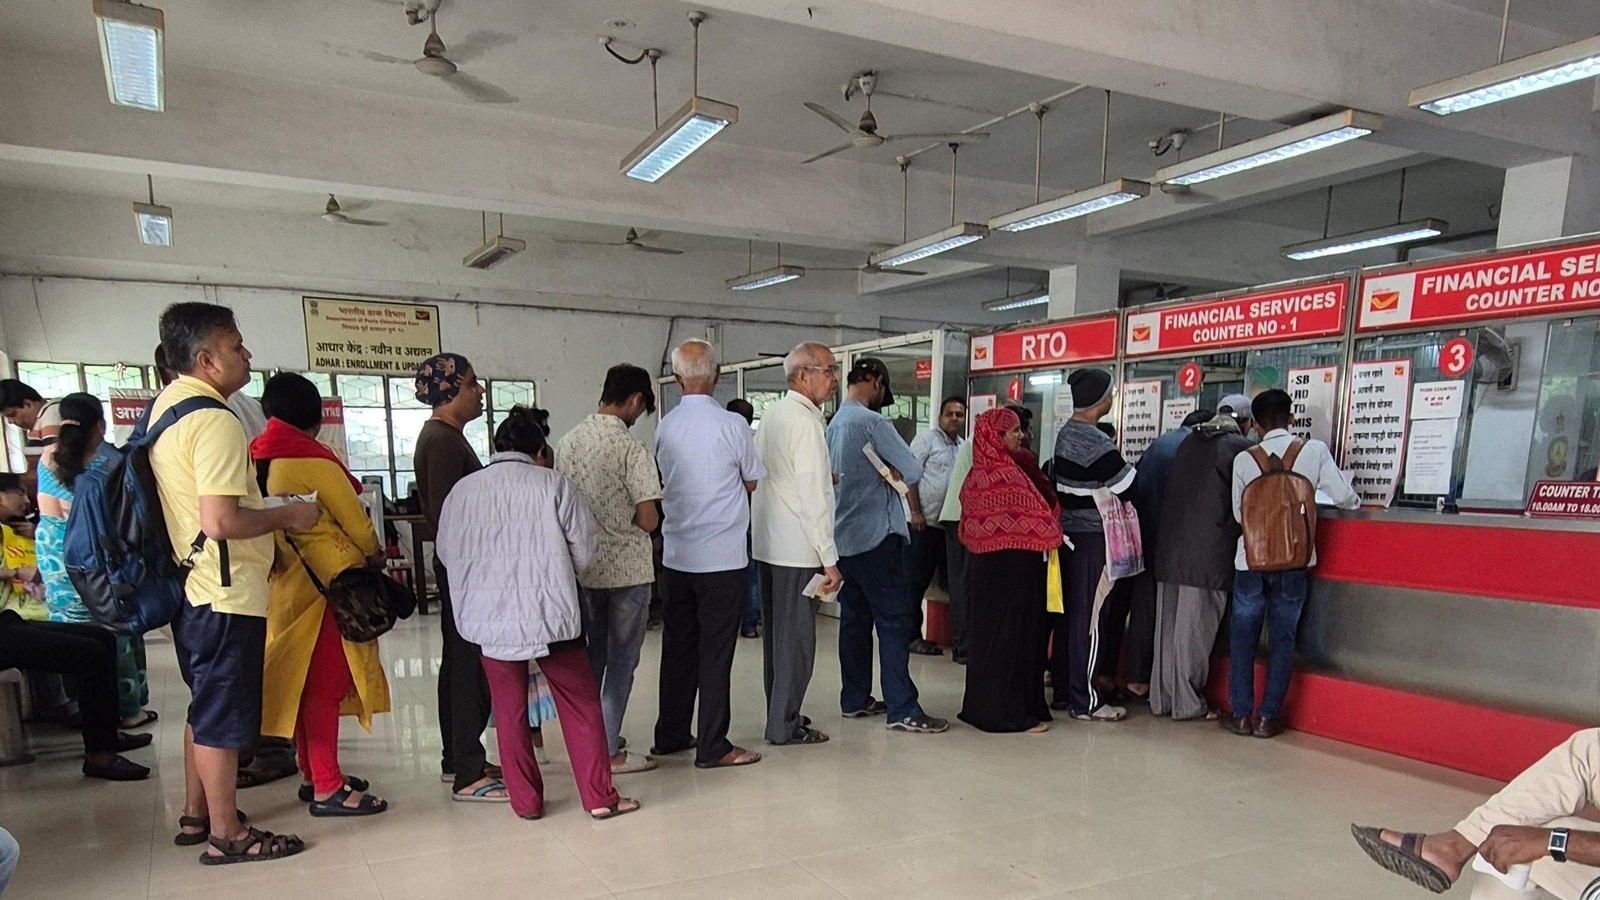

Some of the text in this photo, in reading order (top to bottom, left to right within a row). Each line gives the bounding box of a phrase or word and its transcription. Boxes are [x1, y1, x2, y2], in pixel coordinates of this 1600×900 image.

[1422, 261, 1551, 295] FINANCIAL
[1466, 278, 1600, 311] COUNTER NO
[339, 306, 365, 316] भारतीय
[385, 308, 406, 318] विभाग
[1164, 291, 1336, 330] FINANCIAL SERVICES
[1193, 324, 1254, 344] COUNTER
[1258, 320, 1278, 336] NO
[1290, 317, 1297, 332] 1
[316, 342, 344, 353] आधार
[347, 340, 362, 355] केंद्र
[370, 342, 392, 355] नवीन
[395, 346, 401, 355] व
[404, 347, 432, 357] अद्यतन
[1022, 331, 1066, 361] RTO
[316, 357, 340, 367] ADHAR
[346, 358, 393, 370] ENROLLMENT
[396, 362, 400, 370] &
[402, 362, 419, 371] UPDA
[1448, 344, 1466, 372] 3
[1184, 368, 1194, 386] 2
[1295, 375, 1310, 385] SB
[1011, 381, 1018, 400] 1
[1294, 390, 1308, 399] RD
[1293, 404, 1305, 414] TD
[1377, 398, 1393, 408] योजना
[1292, 418, 1312, 428] MIS
[1384, 414, 1400, 423] योजना
[1387, 429, 1403, 439] योजना
[1376, 476, 1392, 485] योजना
[1540, 485, 1590, 498] COUNTER
[1532, 502, 1600, 513] 10.00AM TO 18.00
